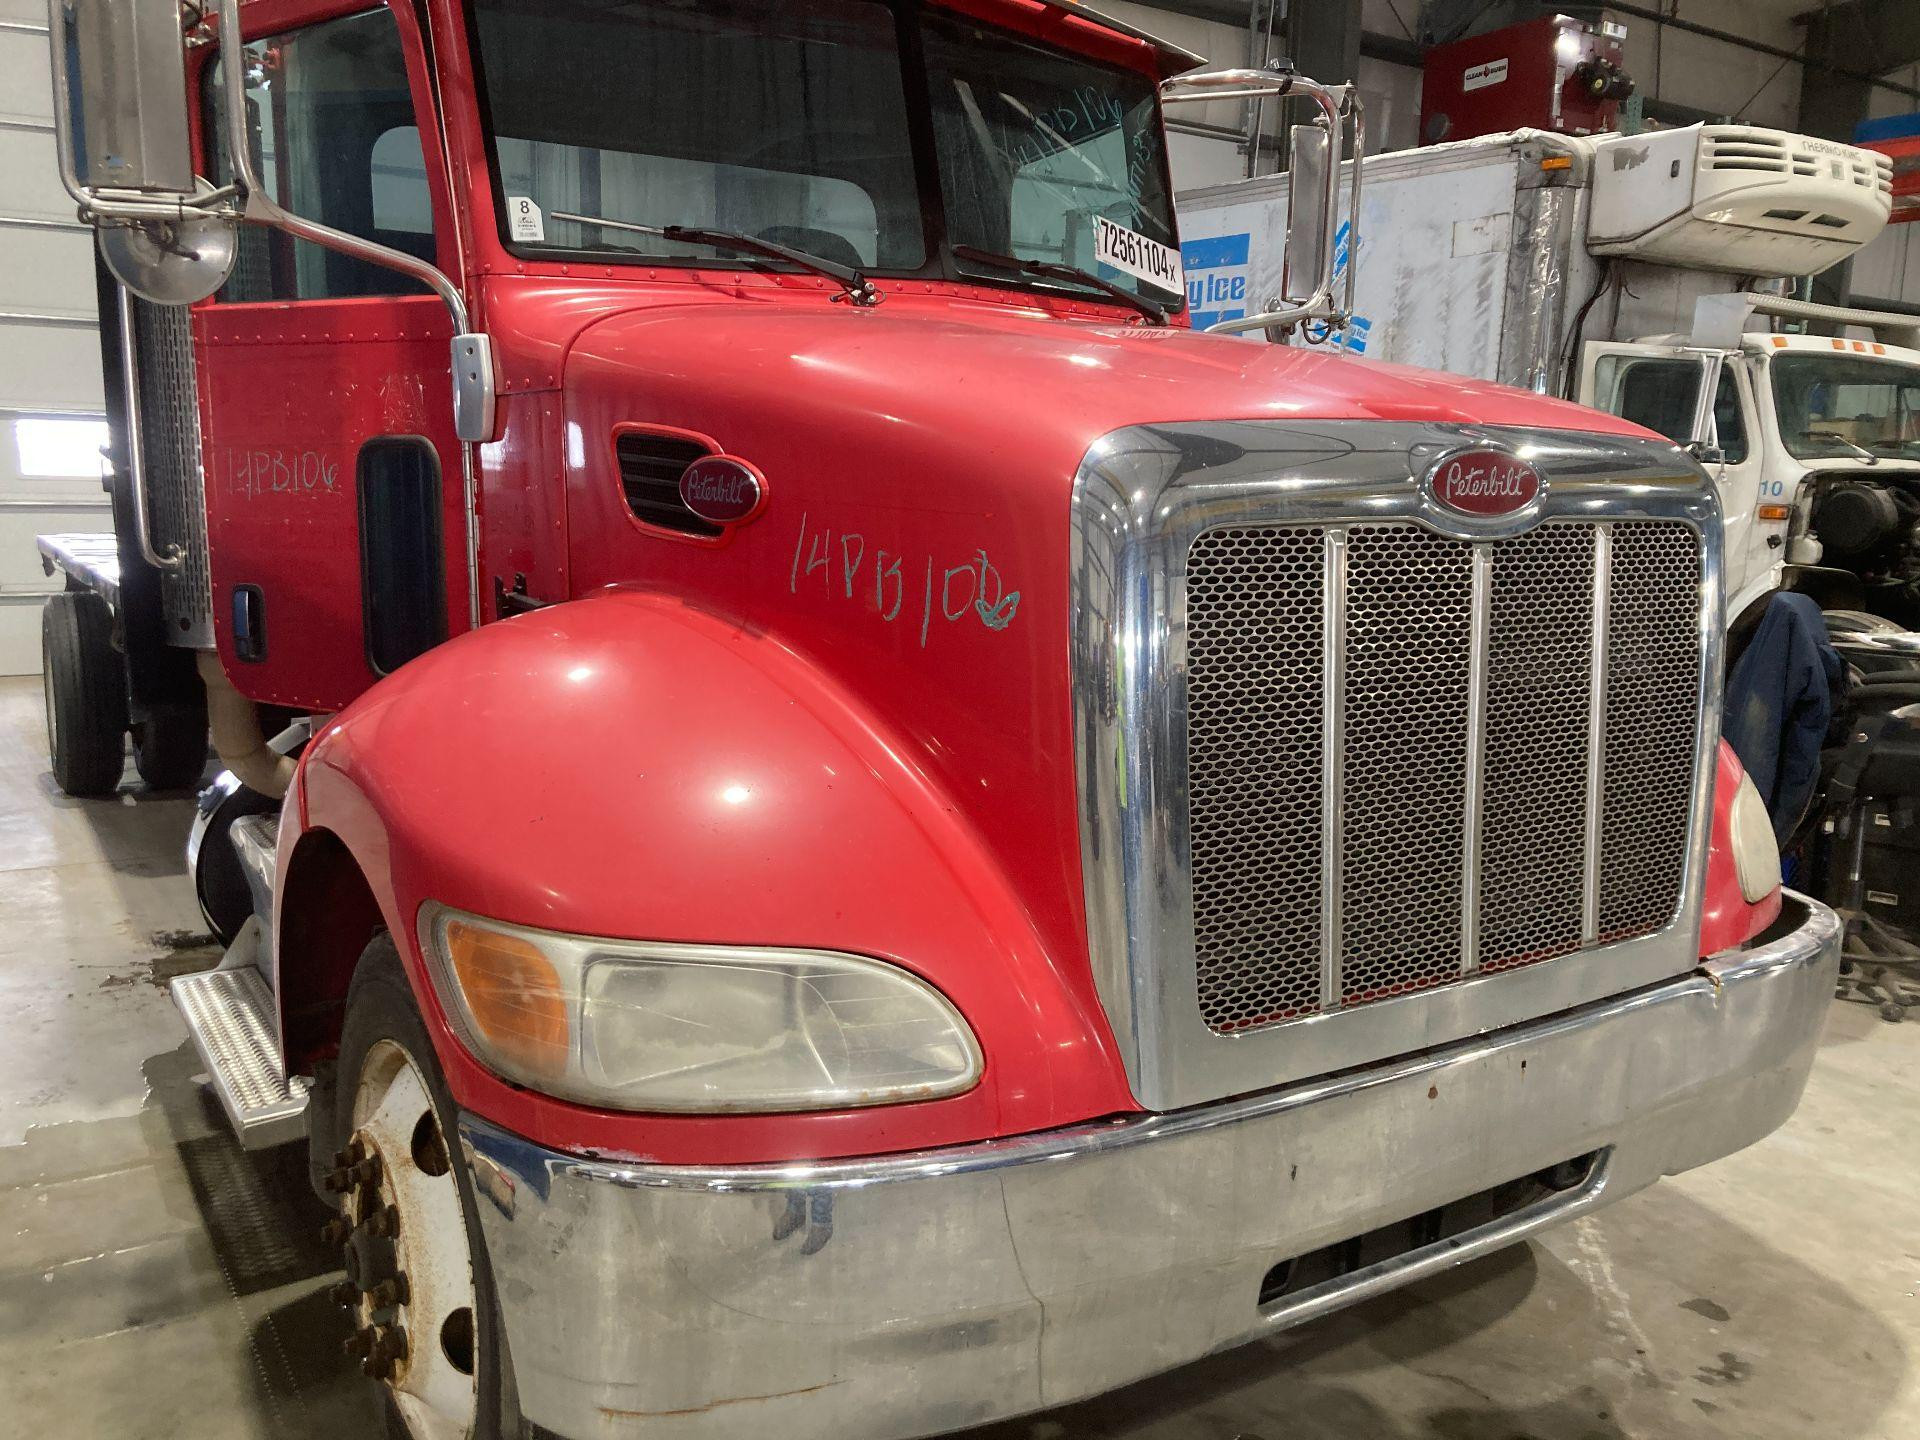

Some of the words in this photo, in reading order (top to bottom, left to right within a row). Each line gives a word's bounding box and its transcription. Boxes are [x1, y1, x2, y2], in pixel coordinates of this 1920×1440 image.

[1466, 71, 1483, 80] CLEAN
[1802, 141, 1841, 156] THERMO
[520, 200, 530, 214] 8
[1206, 273, 1246, 303] Ice
[687, 468, 751, 505] Peterbilt
[1445, 461, 1531, 500] Peterbilt
[1760, 480, 1784, 498] 10
